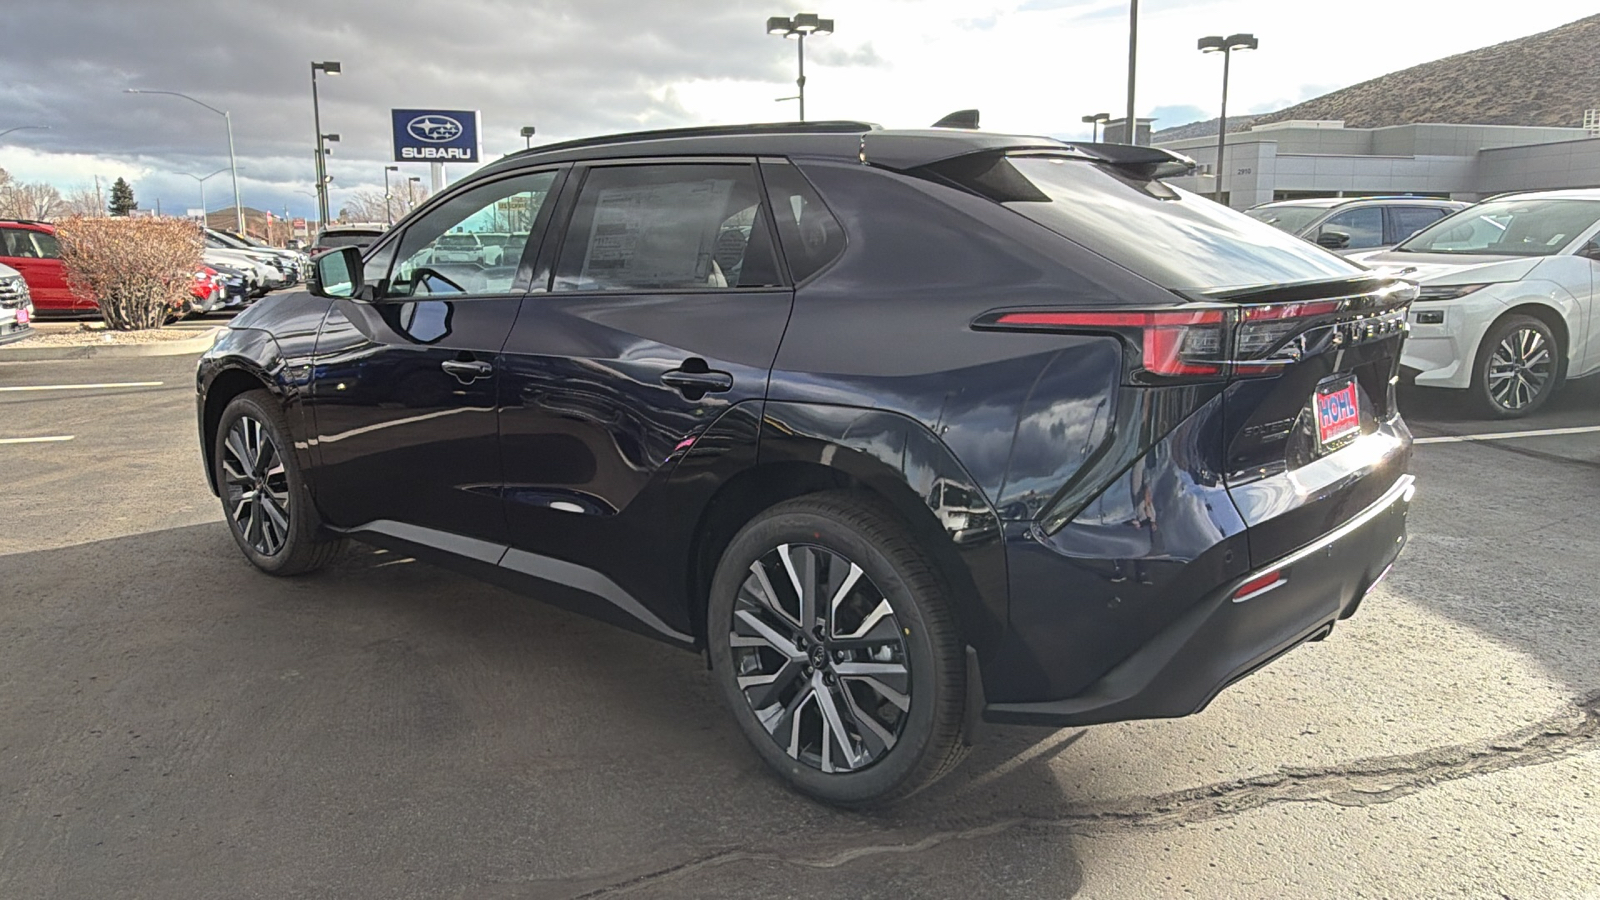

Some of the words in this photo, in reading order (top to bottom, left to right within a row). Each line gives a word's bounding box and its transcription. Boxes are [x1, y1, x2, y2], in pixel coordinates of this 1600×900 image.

[402, 147, 471, 159] SUBARU
[1332, 317, 1405, 344] SUBARU
[1318, 390, 1355, 428] HOHL
